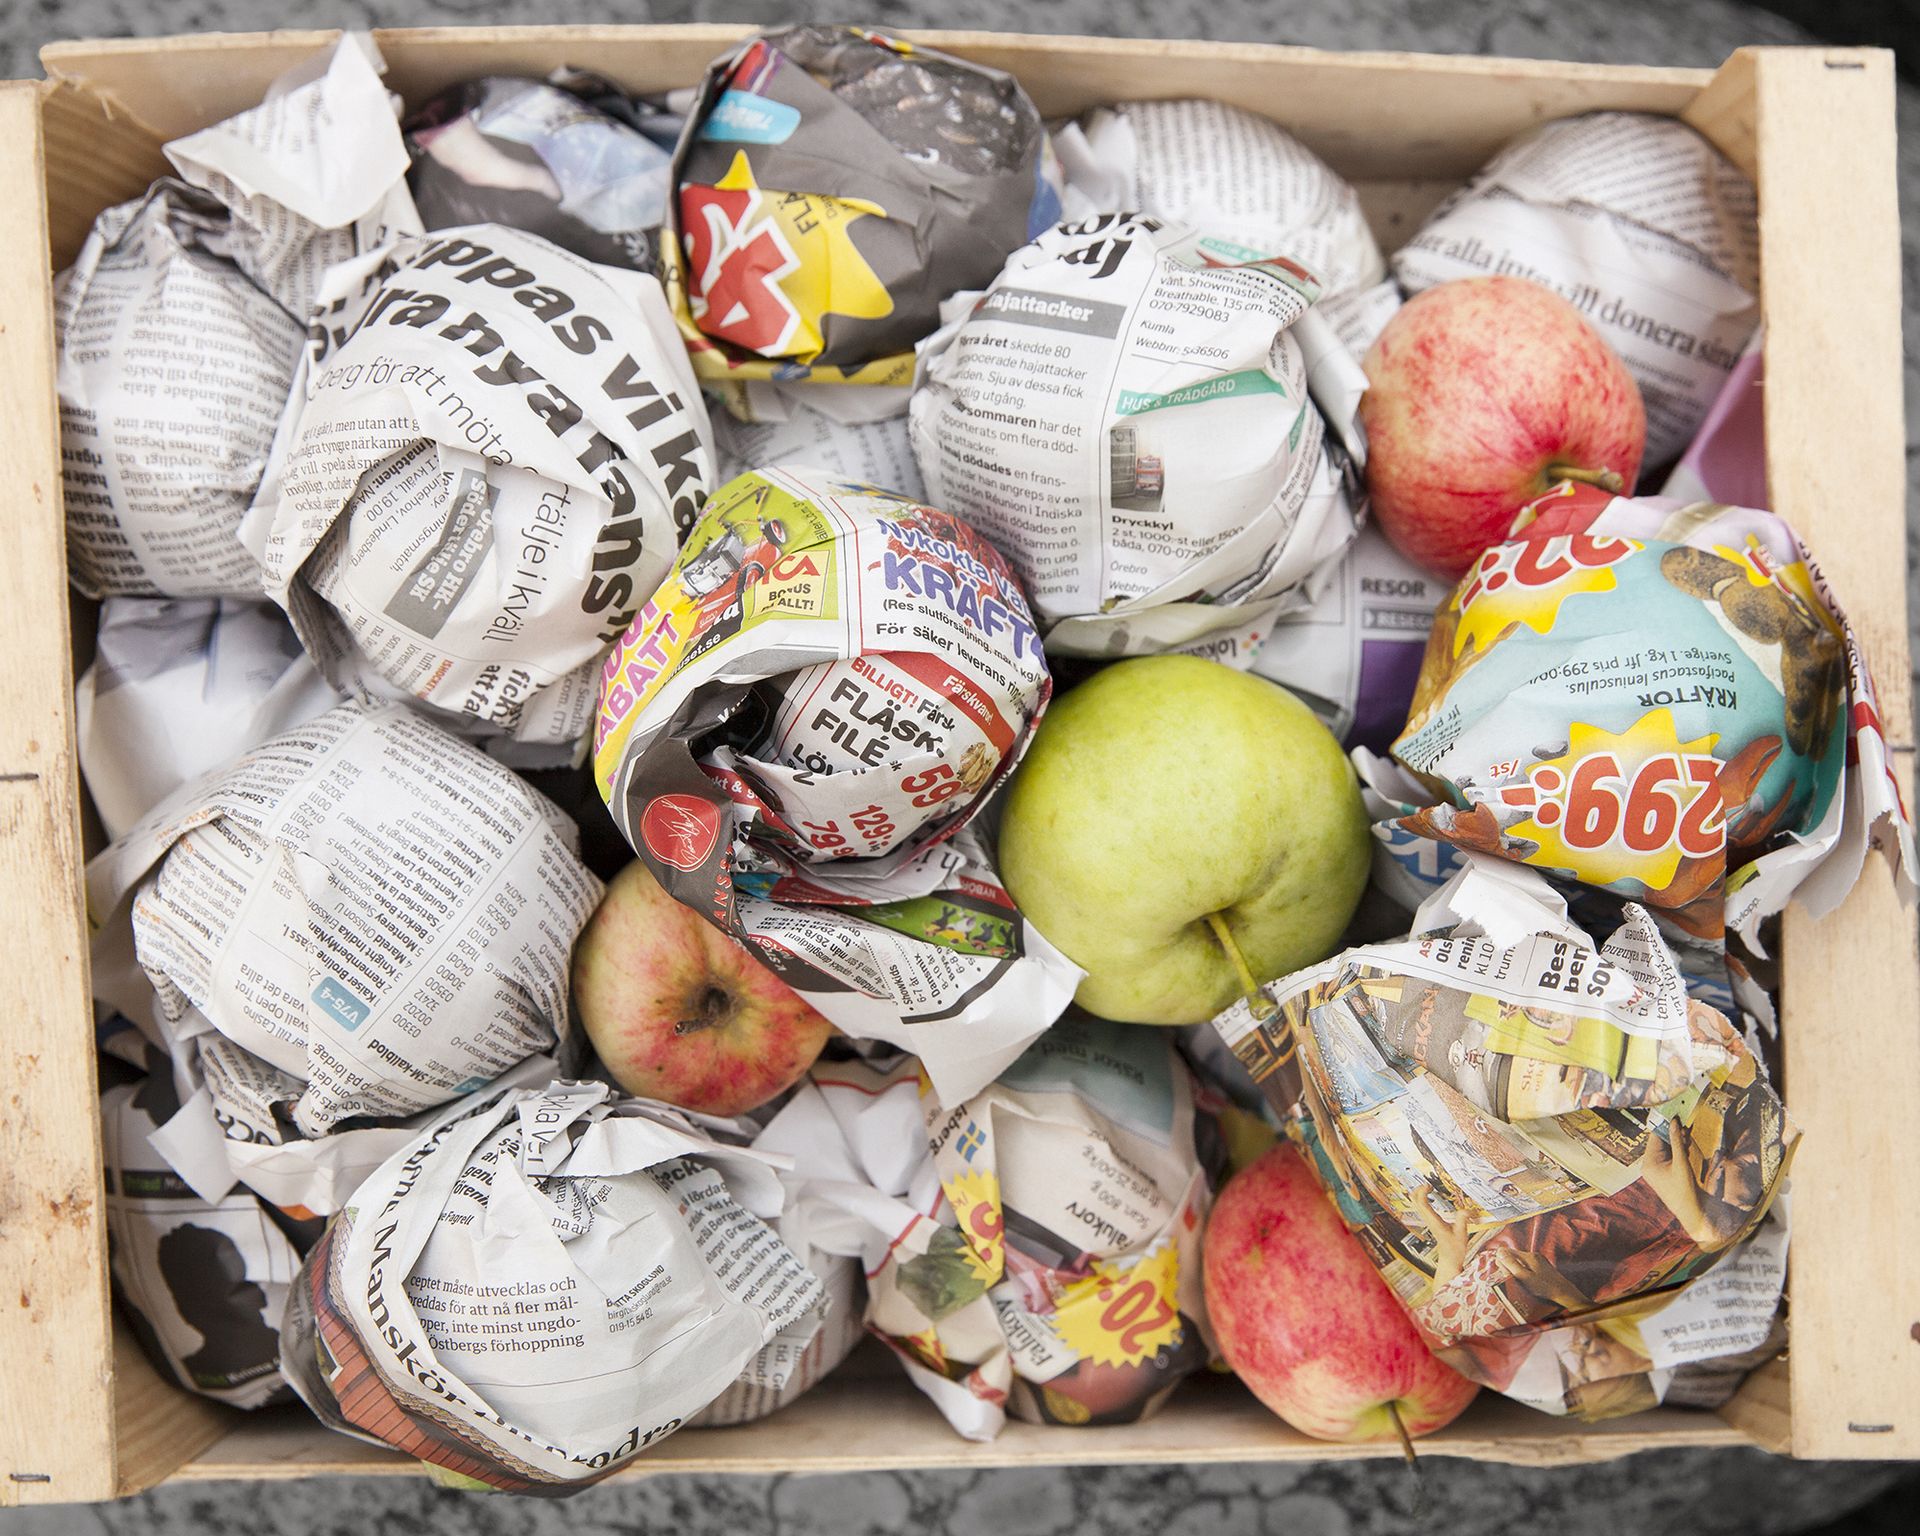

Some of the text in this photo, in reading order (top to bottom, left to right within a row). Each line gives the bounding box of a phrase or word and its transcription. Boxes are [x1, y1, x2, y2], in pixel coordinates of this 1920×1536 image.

[1223, 297, 1242, 311] 135
[1139, 319, 1176, 335] Kumla
[1009, 339, 1052, 356] skedde
[1053, 346, 1071, 359] 80
[365, 356, 403, 385] för
[1018, 359, 1088, 381] hajattacker
[601, 353, 685, 431] vi
[987, 370, 1084, 399] Sju av dessa fick
[1166, 378, 1236, 405] TRÄDGÅRD
[982, 388, 1027, 410] utgång.
[358, 417, 409, 430] utan att
[1039, 418, 1082, 438] har det
[999, 431, 1079, 454] om flera död-
[962, 452, 1067, 488] dödades en frans-
[1034, 505, 1083, 519] Indiska
[1111, 515, 1174, 531] Dryckkyl
[1060, 524, 1077, 534] en
[875, 518, 990, 583] Nykokta
[1022, 538, 1069, 550] samma
[1054, 552, 1078, 564] ung
[407, 571, 436, 602] SK
[1361, 577, 1426, 597] RESOR
[481, 578, 541, 653] kväll
[876, 623, 1007, 687] För säker leverans
[1592, 655, 1620, 675] pris
[1680, 647, 1732, 666] Sverige.
[594, 609, 680, 754] ABATT
[851, 657, 920, 708] BILLIGT!
[1652, 665, 1736, 686] Pacifastacus
[1636, 685, 1738, 710] KRÄFTOR
[830, 677, 945, 758] FLÄSK-
[811, 708, 890, 767] FILÉ
[317, 778, 345, 802] 30215
[434, 778, 461, 801] Marc
[900, 763, 963, 809] 59
[408, 841, 429, 861] Eye
[450, 836, 484, 866] Acriter
[475, 833, 503, 858] RANK:
[390, 850, 415, 872] Love
[425, 853, 466, 888] Krypton
[440, 848, 476, 879] Nimble
[363, 867, 389, 890] Marc
[390, 868, 449, 914] Guiding Star
[413, 864, 459, 902] Kentucky
[371, 892, 397, 915] Boko
[396, 892, 439, 927] Satisfied
[341, 907, 406, 964] Mareld Ohlsson
[372, 910, 419, 951] Monterey
[394, 909, 428, 939] Berkut
[335, 924, 397, 976] Knight Indika
[237, 963, 282, 997] det allra
[314, 949, 376, 1002] Kaiser Broline
[424, 975, 454, 1002] 03500
[914, 953, 941, 998] Dansmix
[232, 980, 286, 1019] Open Trot
[318, 986, 359, 1022] V75-4
[402, 1000, 432, 1026] 00202
[240, 1004, 276, 1033] Casino
[391, 1012, 421, 1038] 03300
[308, 1041, 362, 1089] på lördag.
[442, 1278, 474, 1297] måste
[476, 1279, 546, 1298] utvecklas
[549, 1276, 577, 1292] och
[449, 1296, 579, 1316] för att nå fler mål-
[452, 1316, 582, 1336] inte minst ungdo-
[428, 1332, 585, 1354] Östbergs förhoppning
